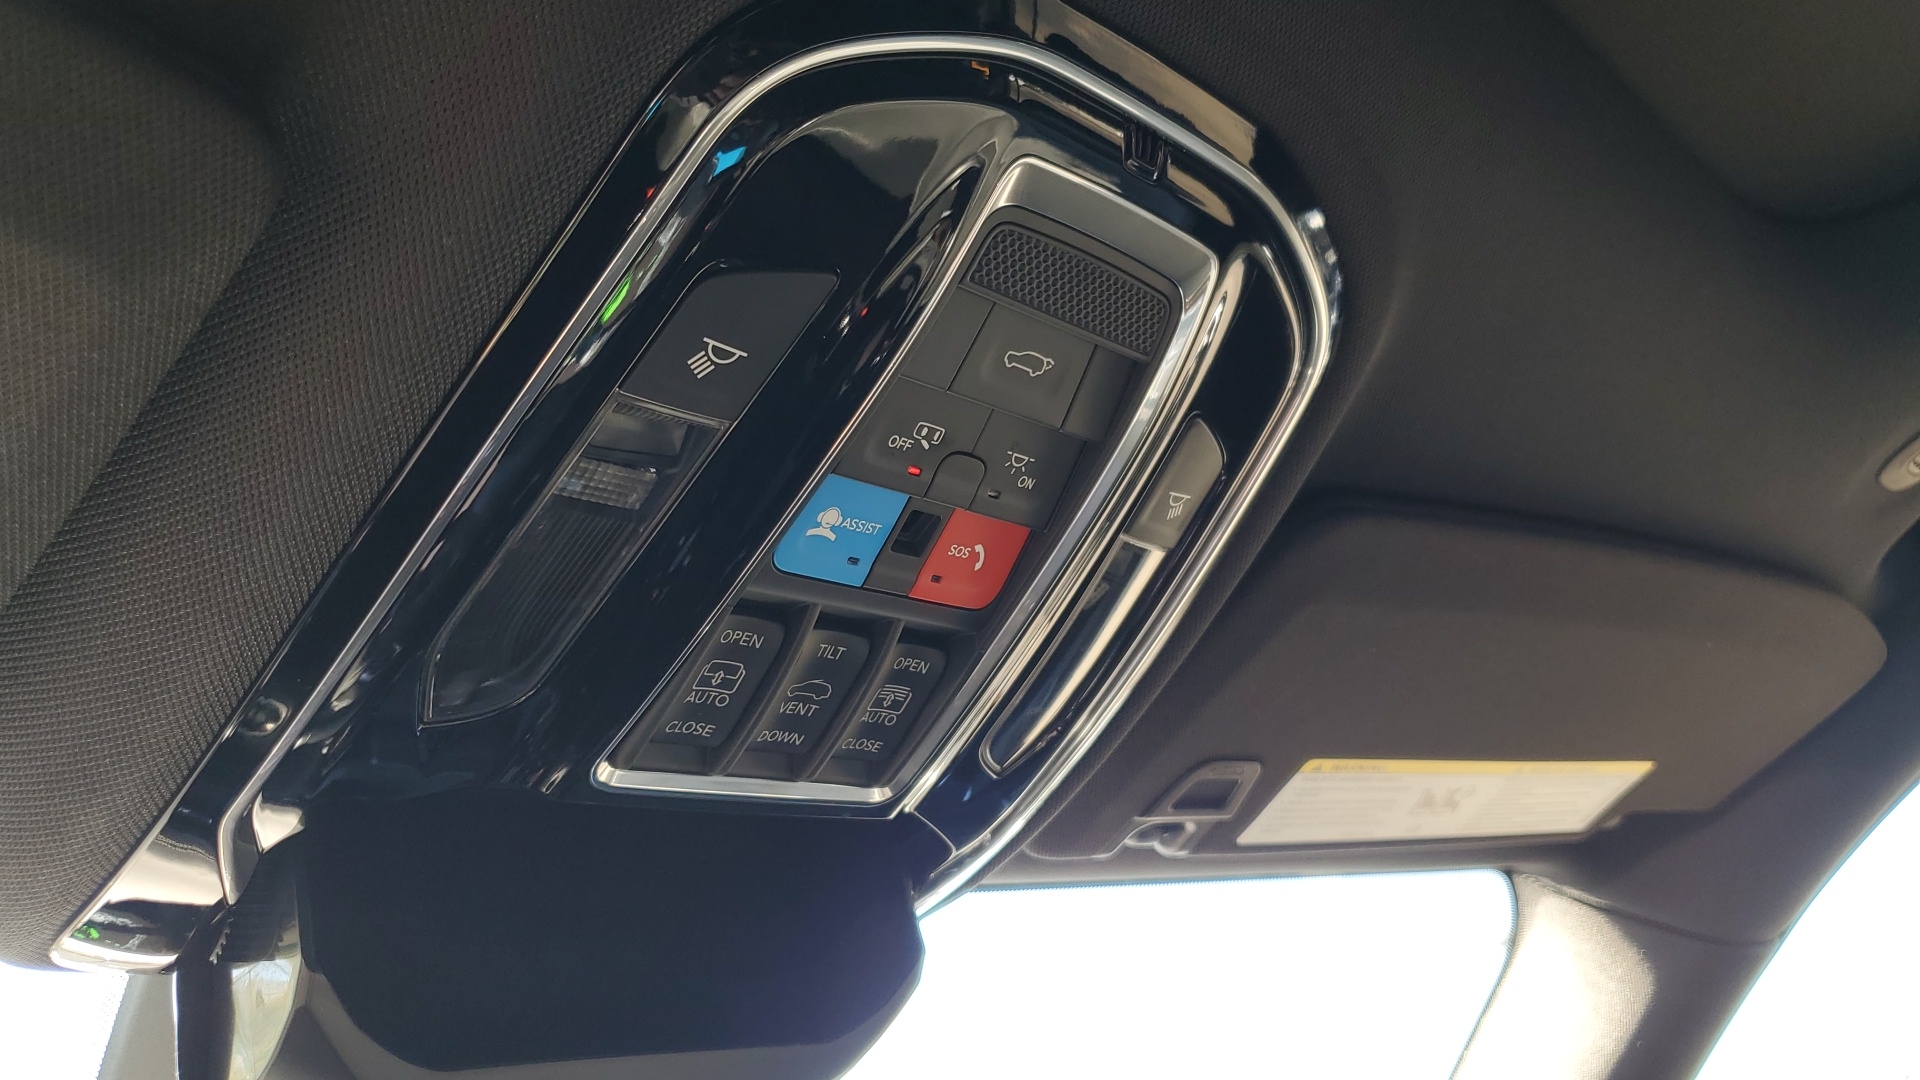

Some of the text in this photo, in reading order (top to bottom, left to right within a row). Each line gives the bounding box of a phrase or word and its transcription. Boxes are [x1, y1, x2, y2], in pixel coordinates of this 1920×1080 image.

[888, 435, 914, 451] OFF
[1017, 476, 1036, 490] ON
[841, 517, 882, 536] ASSIST
[947, 544, 971, 559] SOS
[720, 629, 764, 649] OPEN
[817, 644, 847, 661] TILT
[893, 657, 930, 675] OPEN
[684, 691, 730, 707] AUTO
[779, 702, 819, 717] VENT
[861, 712, 898, 726] AUTO
[665, 721, 716, 737] CLOSE
[757, 730, 804, 746] DOWN
[841, 738, 883, 753] CLOSE
